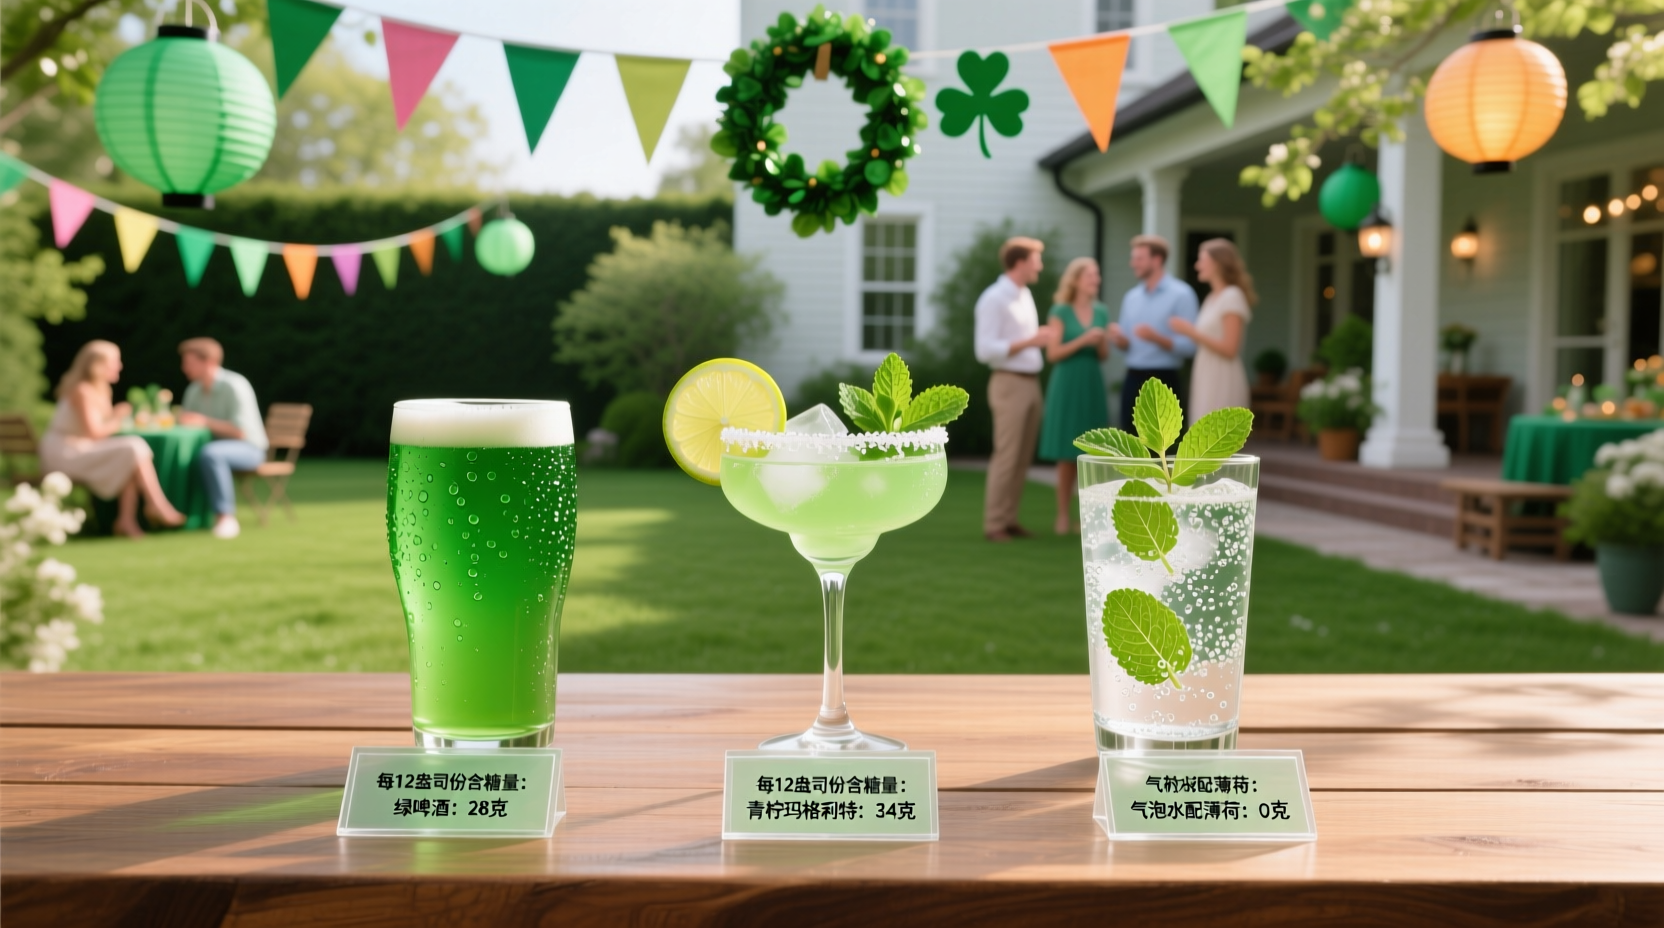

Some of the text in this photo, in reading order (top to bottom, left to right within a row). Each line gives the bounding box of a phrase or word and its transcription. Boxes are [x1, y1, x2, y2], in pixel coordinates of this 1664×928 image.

[376, 772, 526, 791] 每12盎司份含糖量：
[757, 775, 906, 794] 每12盎司份含糖量：
[393, 798, 509, 818] 绿啤酒：28克
[746, 800, 916, 820] 青柠玛格利特：34克
[1130, 800, 1291, 820] 气泡水配薄荷：0克
